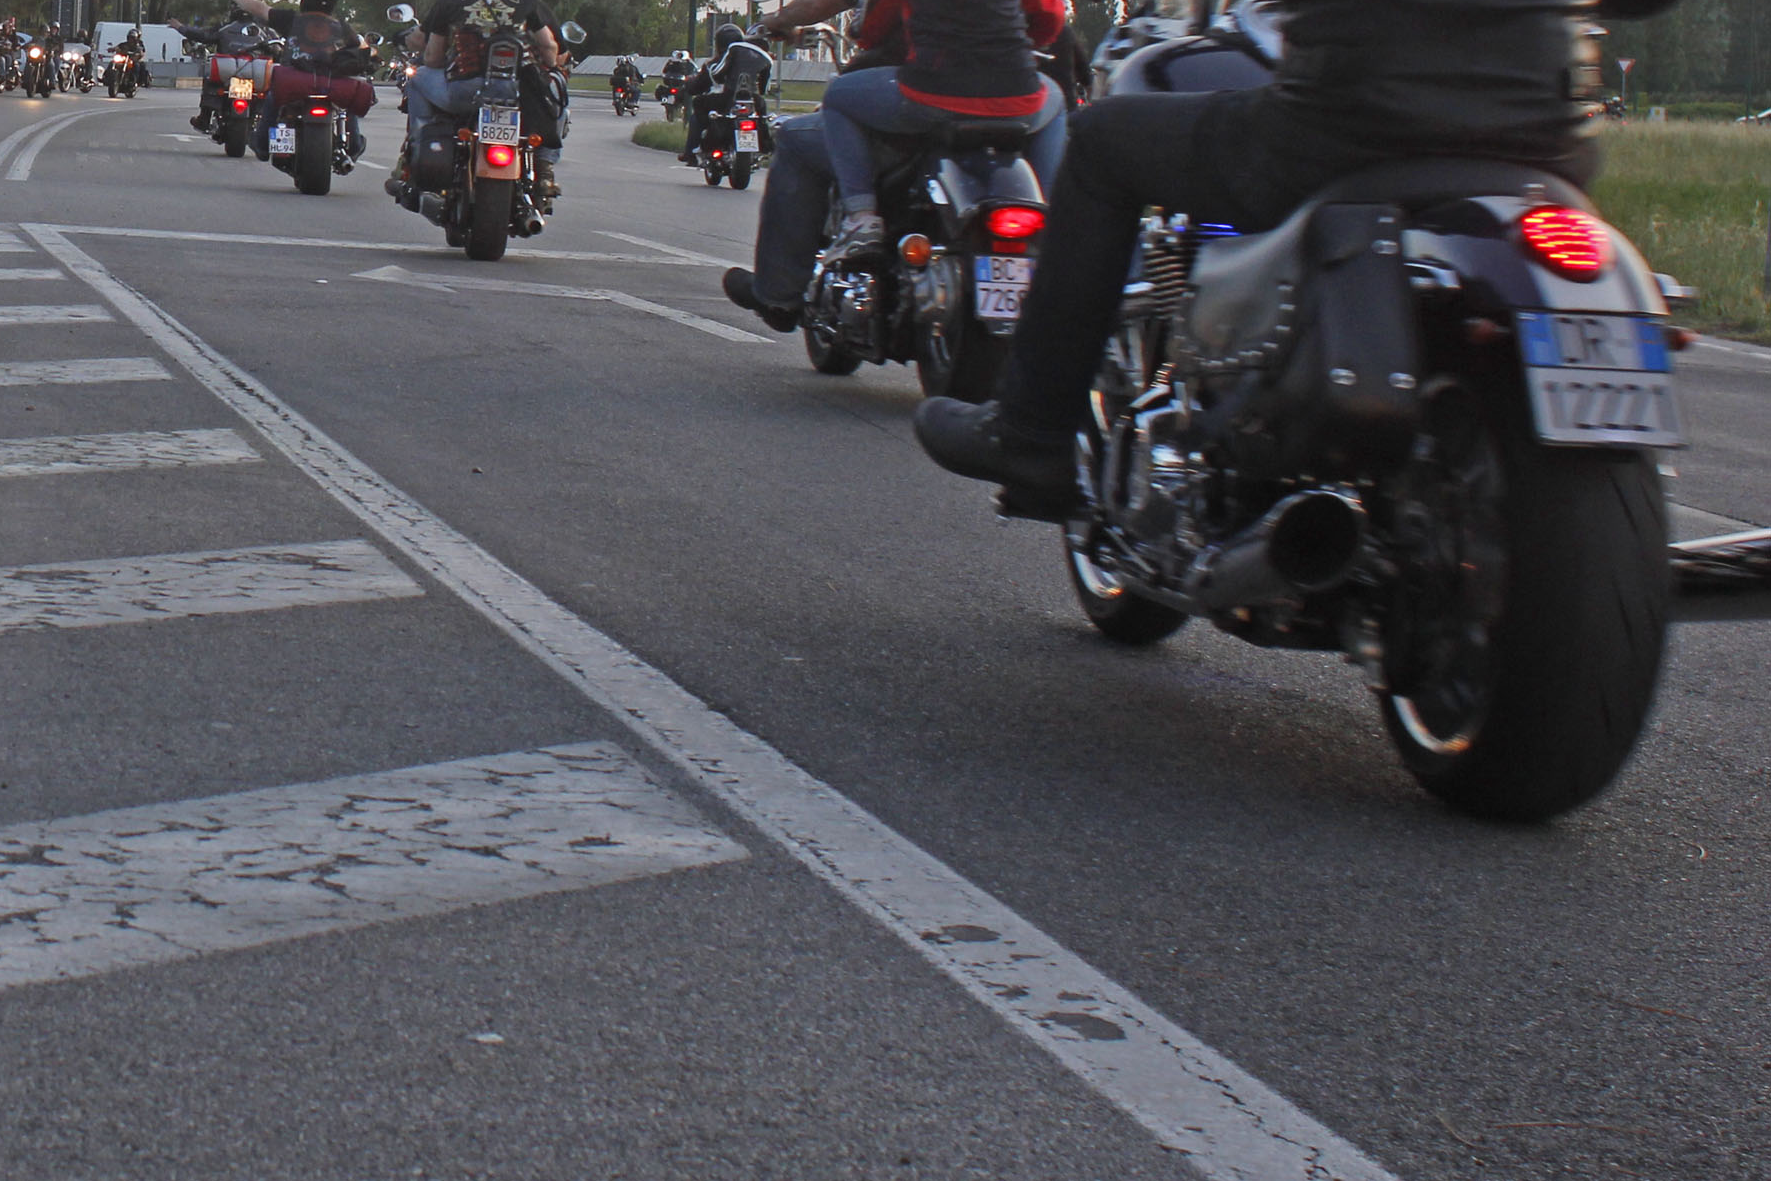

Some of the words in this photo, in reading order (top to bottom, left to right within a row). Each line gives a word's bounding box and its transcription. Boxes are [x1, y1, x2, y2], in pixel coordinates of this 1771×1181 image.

[279, 129, 291, 138] TS
[482, 125, 517, 141] 68267
[991, 257, 1016, 281] BC
